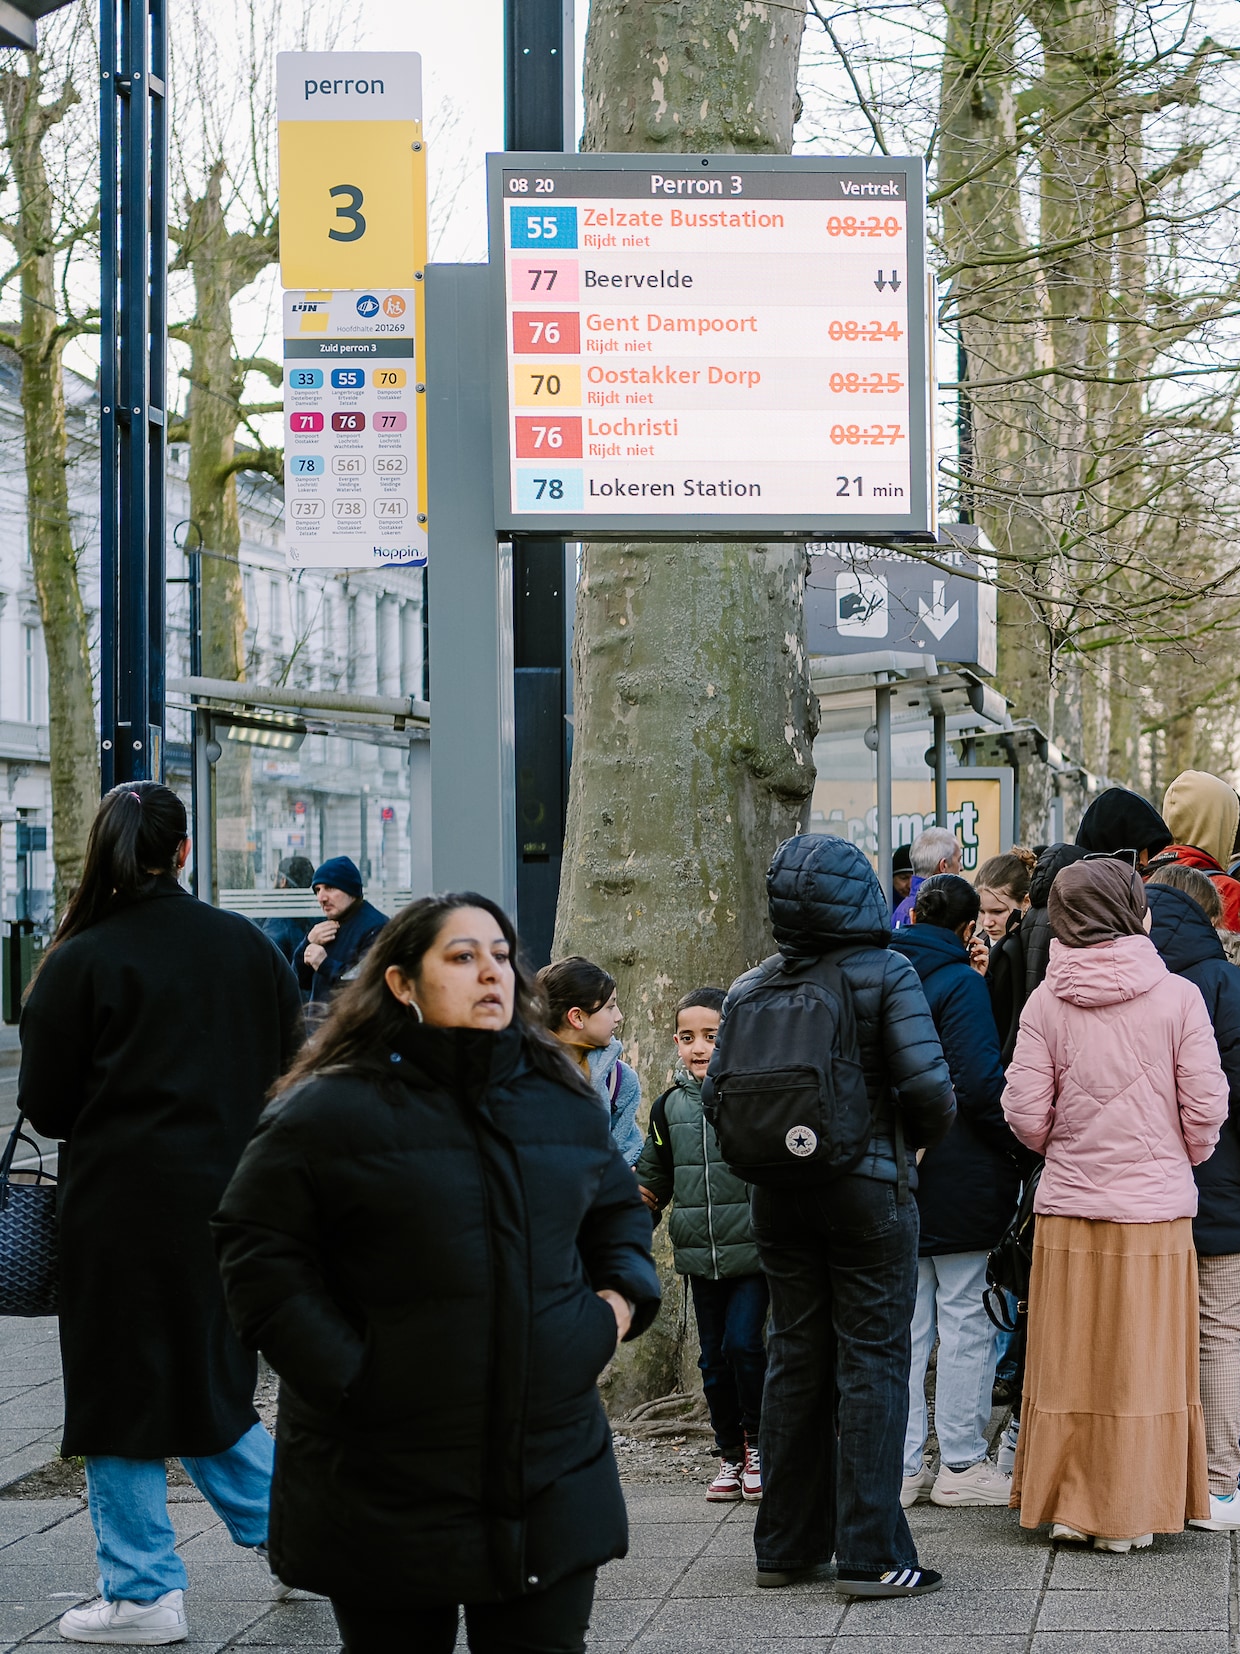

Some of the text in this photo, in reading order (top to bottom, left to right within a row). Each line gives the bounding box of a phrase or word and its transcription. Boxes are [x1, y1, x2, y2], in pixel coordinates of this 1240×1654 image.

[304, 79, 385, 101] perron
[508, 178, 555, 193] 08 20
[650, 174, 743, 196] Perron 3
[839, 179, 900, 197] Vertrek
[328, 184, 367, 243] 3
[583, 208, 785, 228] Zelzate Busstation
[527, 216, 558, 239] 55
[826, 216, 903, 238] 08:20
[583, 233, 651, 250] Rijdt niet
[527, 269, 558, 291] 77
[584, 269, 694, 289] Beervelde
[336, 324, 406, 333] Hoofdhalte 201269
[529, 321, 561, 345] 76
[586, 314, 758, 338] Gent Dampoort
[828, 321, 904, 343] 08:24
[319, 344, 377, 354] Zuid perron 3
[586, 338, 653, 355] Rijdt niet
[298, 373, 315, 385] 33
[338, 373, 357, 385] 55
[380, 373, 397, 385] 70
[530, 374, 561, 396] 70
[587, 365, 761, 389] Oostakker Dorp
[829, 372, 905, 394] 08:25
[587, 390, 654, 407] Rijdt niet
[299, 416, 314, 429] 71
[339, 416, 357, 429] 76
[381, 416, 397, 428] 77
[587, 417, 678, 437] Lochristi
[531, 426, 563, 449] 76
[830, 424, 906, 446] 08:27
[588, 442, 655, 458] Rijdt niet
[298, 460, 315, 472] 78
[337, 460, 361, 472] 561
[377, 460, 403, 472] 562
[532, 478, 564, 500] 78
[589, 477, 762, 497] Lokeren Station
[835, 476, 904, 497] 21 min
[296, 503, 319, 515] 737
[336, 503, 361, 515] 738
[379, 503, 401, 515] 741
[373, 545, 419, 560] Hoppin
